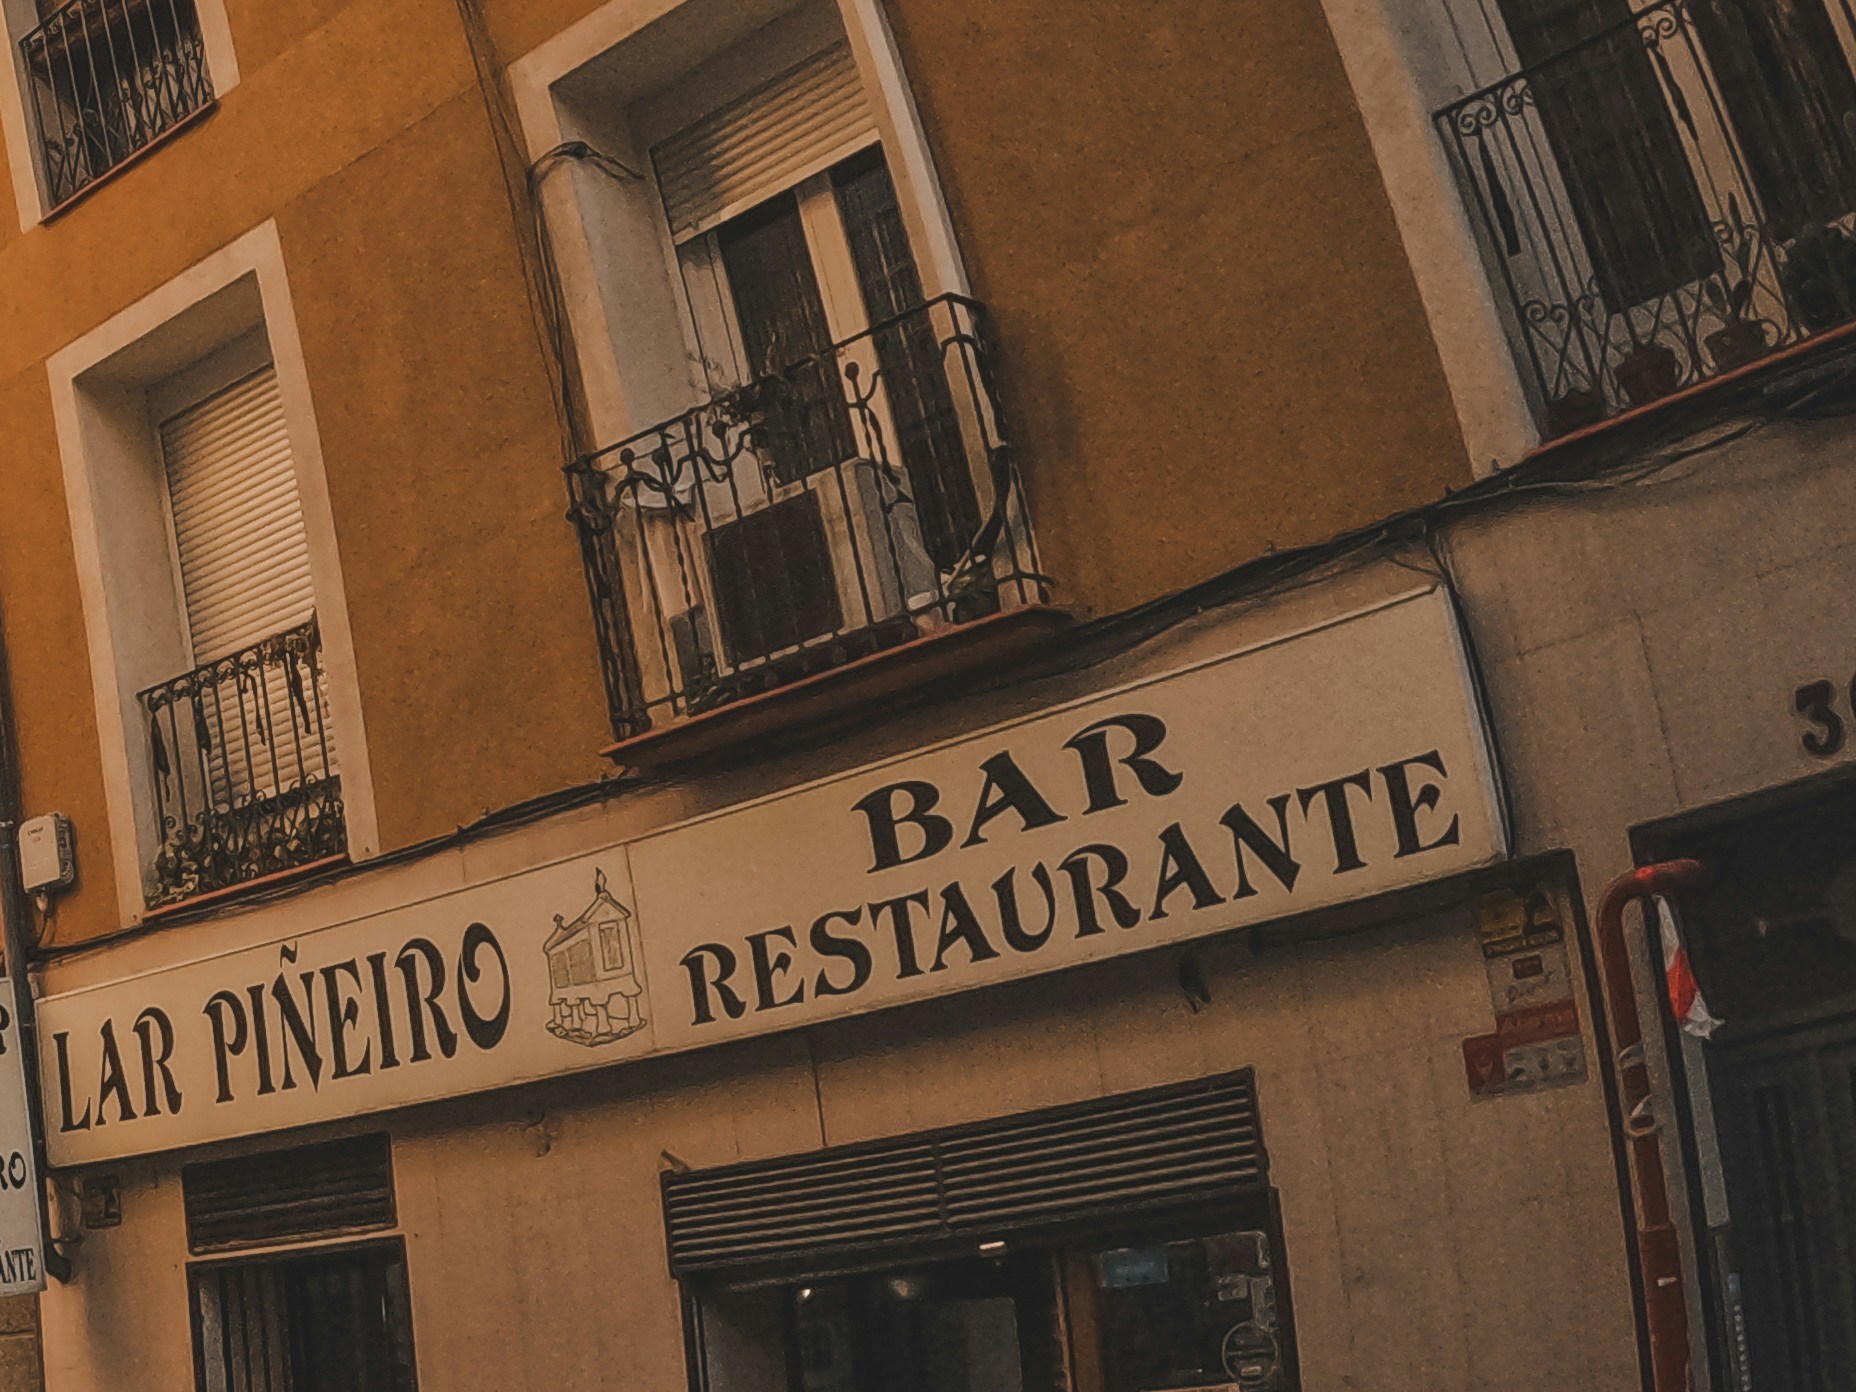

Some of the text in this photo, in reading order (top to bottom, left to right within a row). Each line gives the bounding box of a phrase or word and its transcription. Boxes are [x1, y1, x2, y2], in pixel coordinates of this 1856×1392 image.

[679, 749, 1460, 1026] RESTAURANTE
[851, 713, 1184, 874] BAR
[52, 921, 511, 1134] LAR PIÑEIRO
